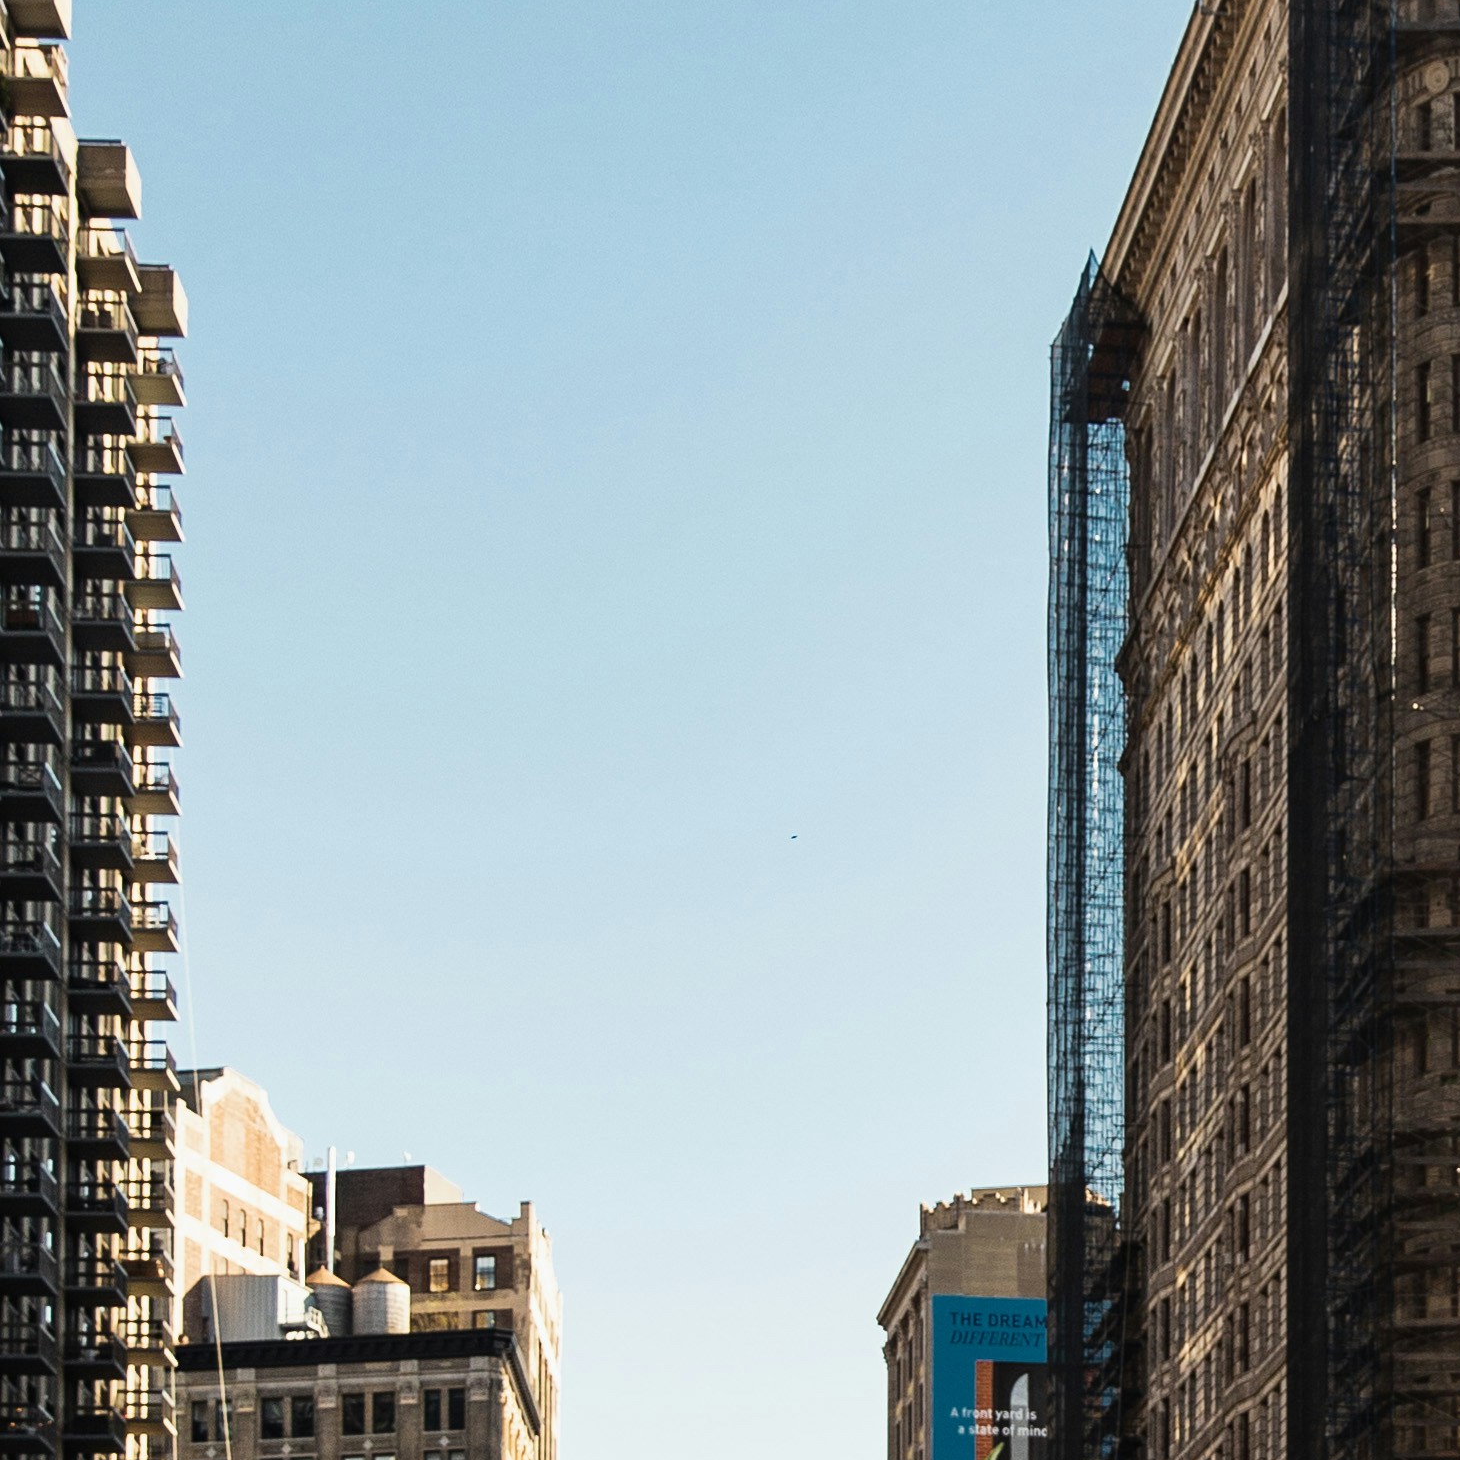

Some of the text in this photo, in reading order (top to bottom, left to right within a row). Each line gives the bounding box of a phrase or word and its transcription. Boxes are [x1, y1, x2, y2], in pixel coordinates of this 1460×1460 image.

[950, 1312, 982, 1326] THE
[950, 1330, 1045, 1347] DIFFERENT
[950, 1407, 1037, 1421] A front yard is
[958, 1425, 965, 1434] a
[968, 1424, 999, 1435] state
[1002, 1424, 1015, 1436] of
